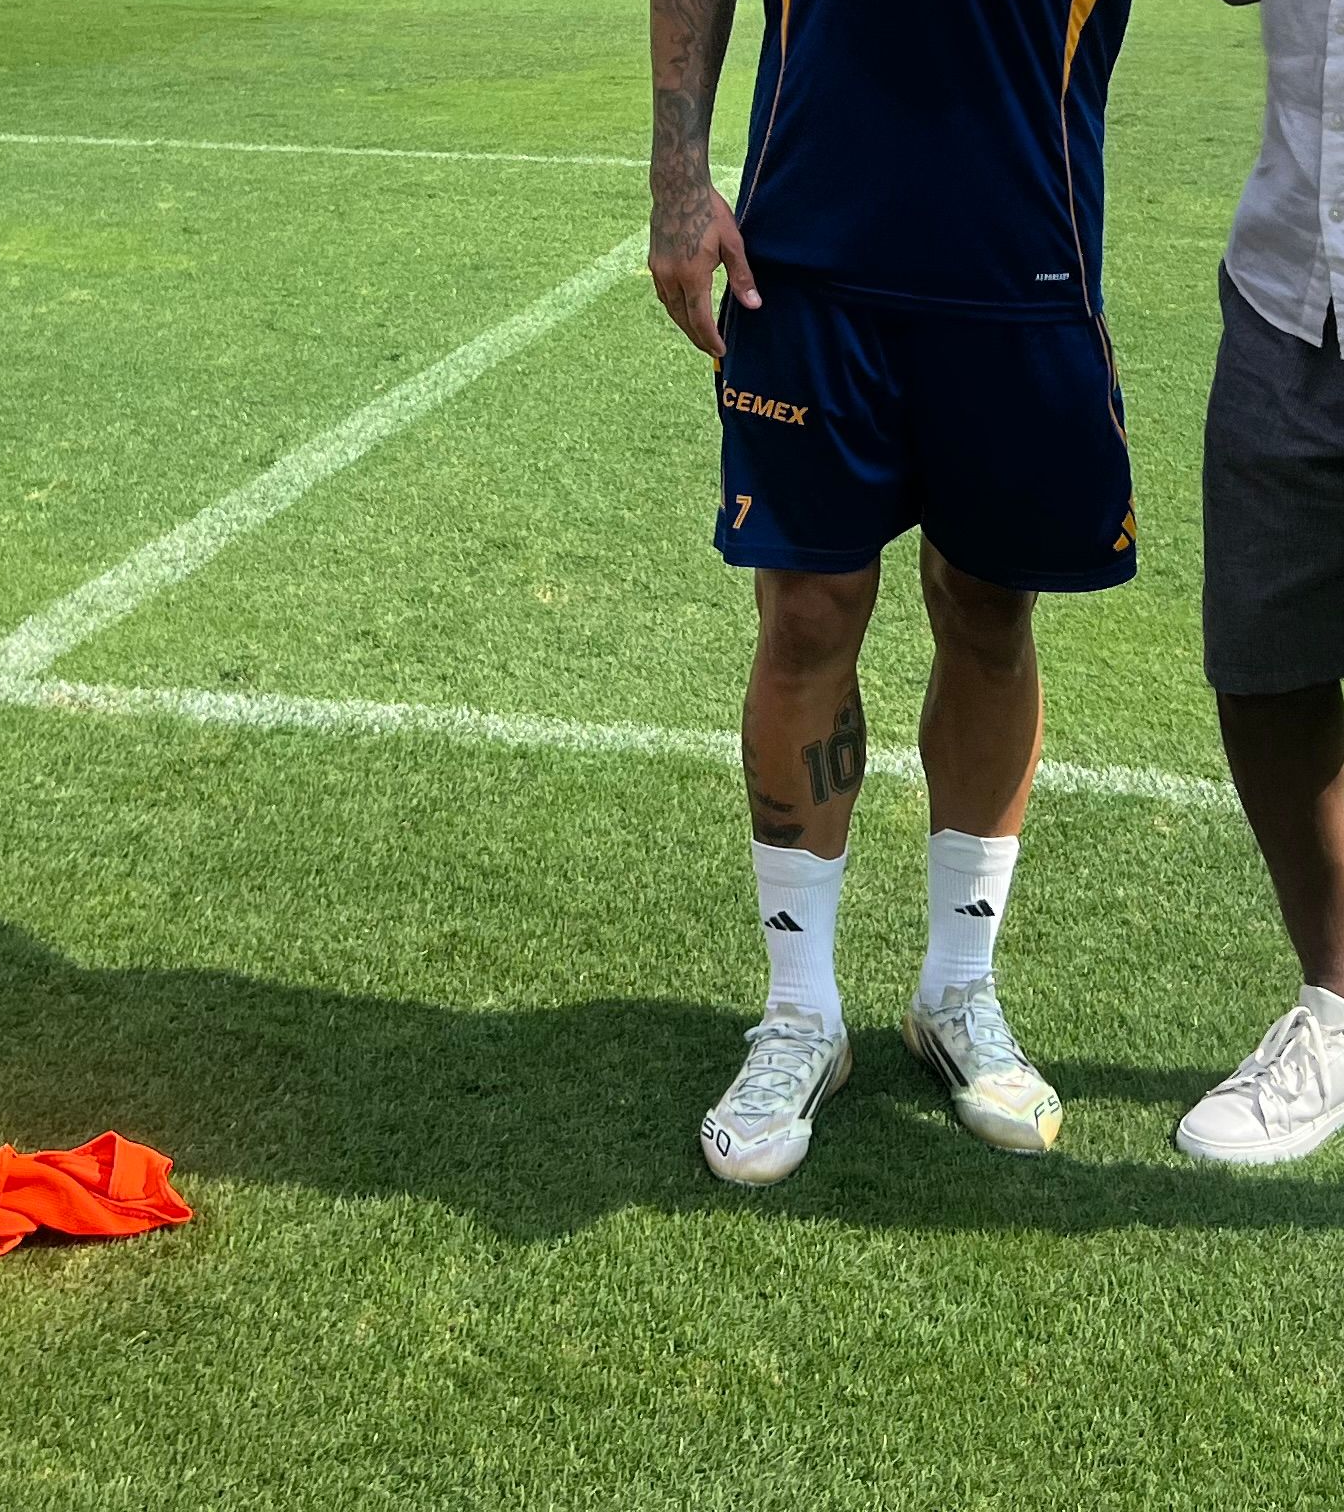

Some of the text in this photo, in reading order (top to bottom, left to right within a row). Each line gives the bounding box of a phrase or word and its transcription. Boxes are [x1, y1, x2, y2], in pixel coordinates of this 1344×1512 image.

[723, 387, 809, 426] CEMEX
[732, 494, 753, 530] 7
[800, 725, 866, 807] 10
